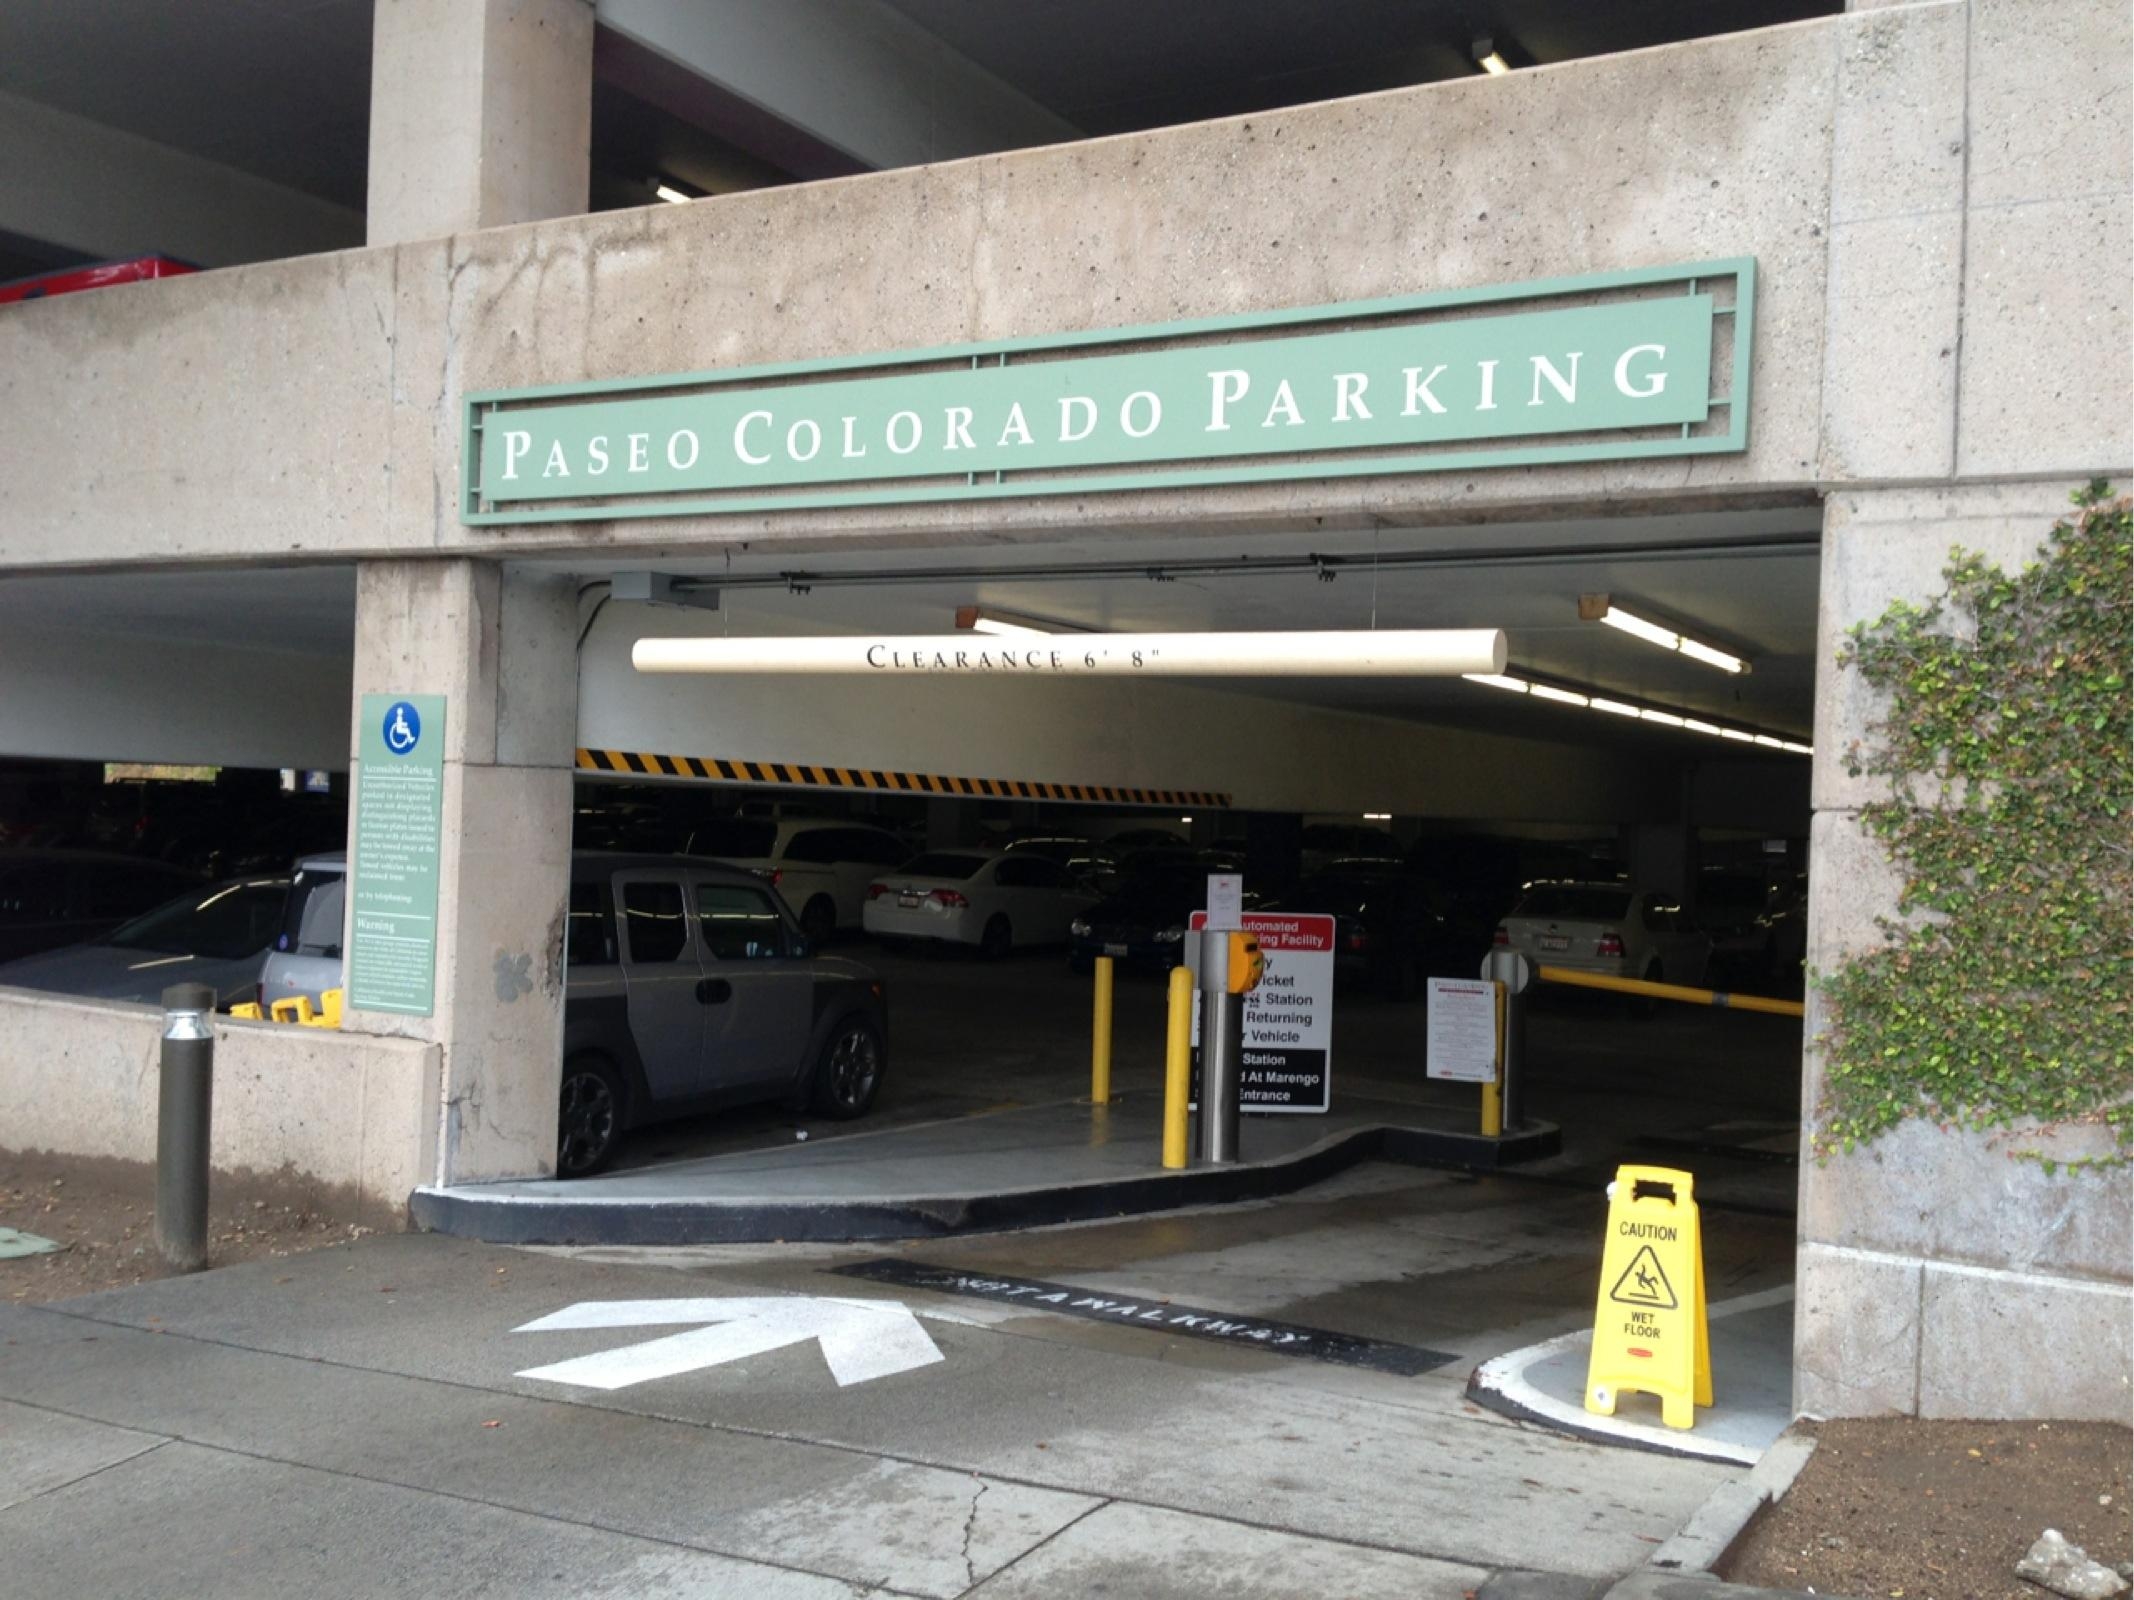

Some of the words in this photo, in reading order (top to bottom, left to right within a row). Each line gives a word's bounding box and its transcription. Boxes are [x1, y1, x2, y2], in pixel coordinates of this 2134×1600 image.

[501, 428, 699, 481] PASEO
[733, 390, 1163, 465] COLORADO
[1204, 344, 1668, 432] PARKING
[866, 644, 1063, 669] CLEARANCE
[403, 765, 433, 777] Parking
[357, 917, 395, 935] Warning
[1242, 921, 1299, 932] utomated
[1282, 933, 1324, 948] Facility
[1262, 975, 1294, 987] icket
[1266, 992, 1313, 1006] Station
[1246, 1012, 1313, 1027] Returning
[1252, 1030, 1300, 1043] Vehicle
[1242, 1053, 1286, 1066] Station
[1248, 1071, 1263, 1083] At
[1266, 1071, 1319, 1086] Marengo
[1619, 1221, 1678, 1241] CAUTION
[1631, 1312, 1655, 1324] WET
[1624, 1323, 1661, 1339] FLOOR
